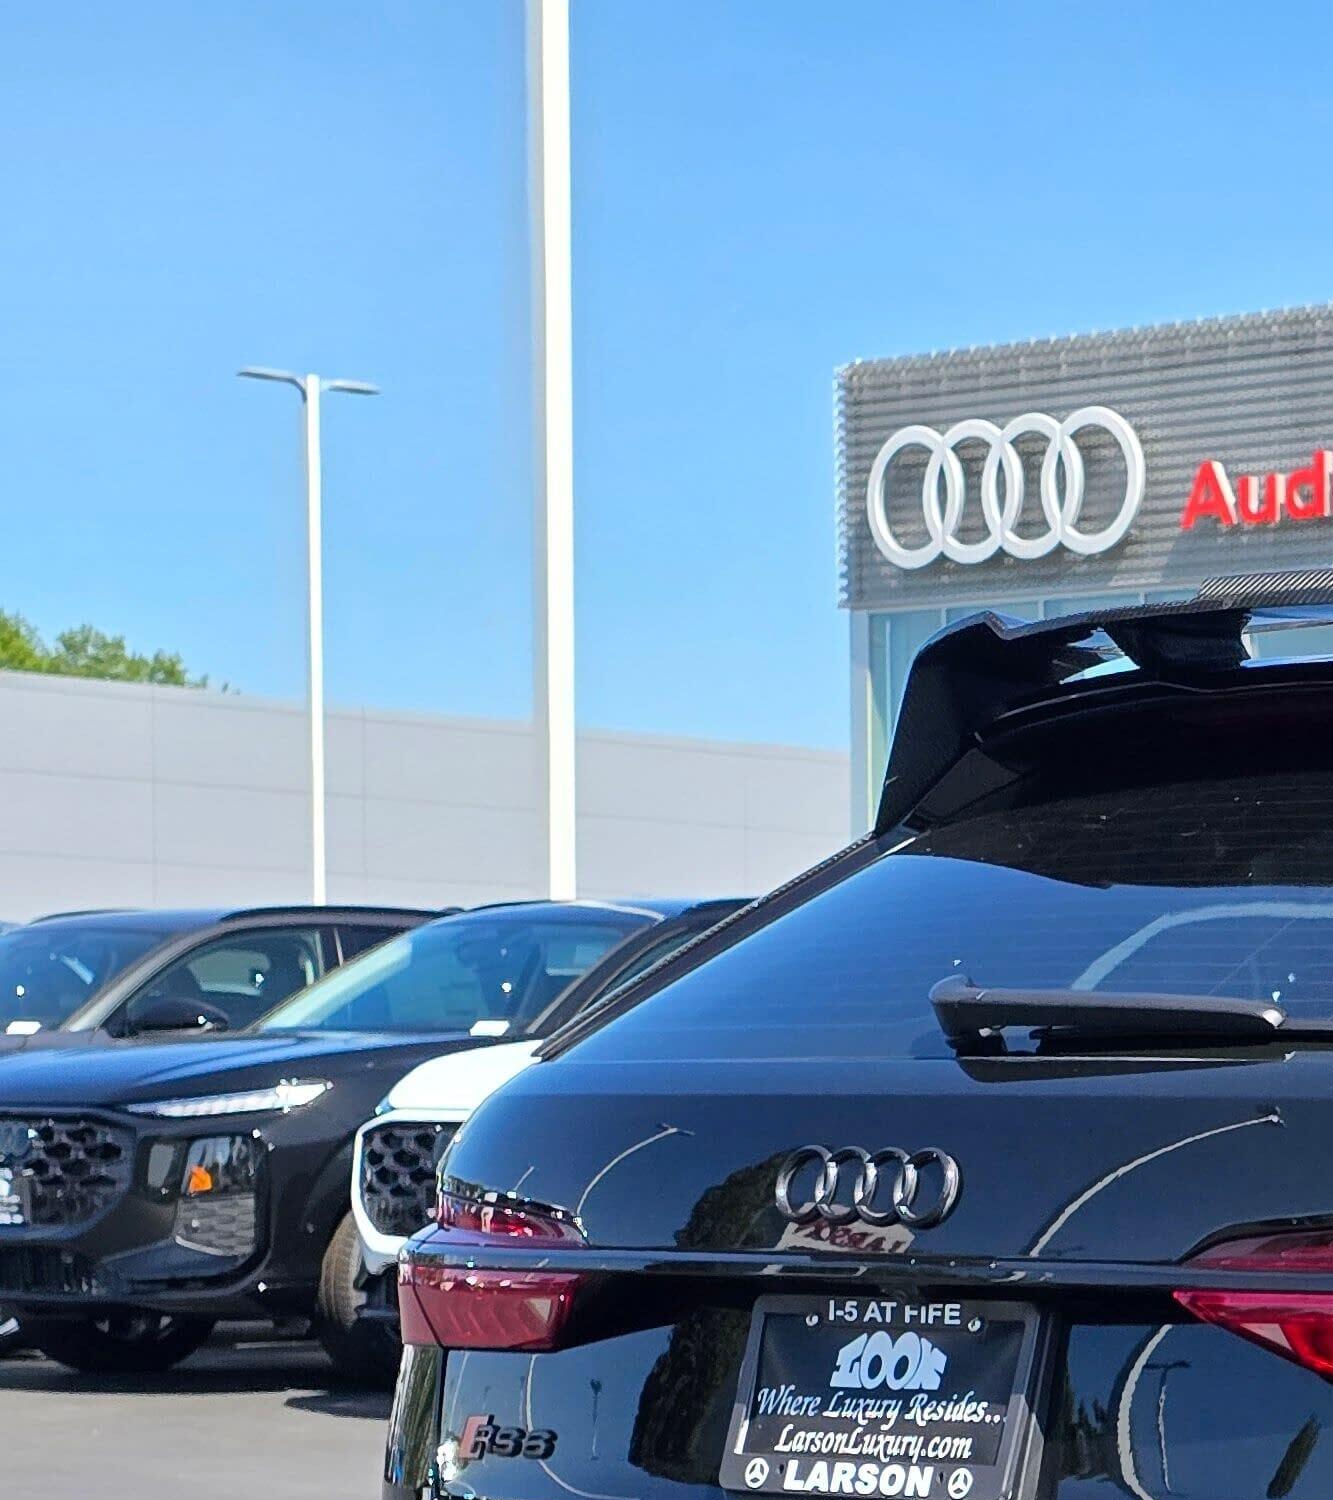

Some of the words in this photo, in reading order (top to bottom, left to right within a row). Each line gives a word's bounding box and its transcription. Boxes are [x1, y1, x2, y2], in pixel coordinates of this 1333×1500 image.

[828, 1299, 858, 1323] I-5
[863, 1301, 897, 1324] AT
[904, 1303, 962, 1326] FIFE
[757, 1384, 822, 1418] Where
[822, 1391, 903, 1431] Luxury
[774, 1423, 973, 1464] LarsonLuxury.com
[783, 1459, 934, 1498] LARSON
